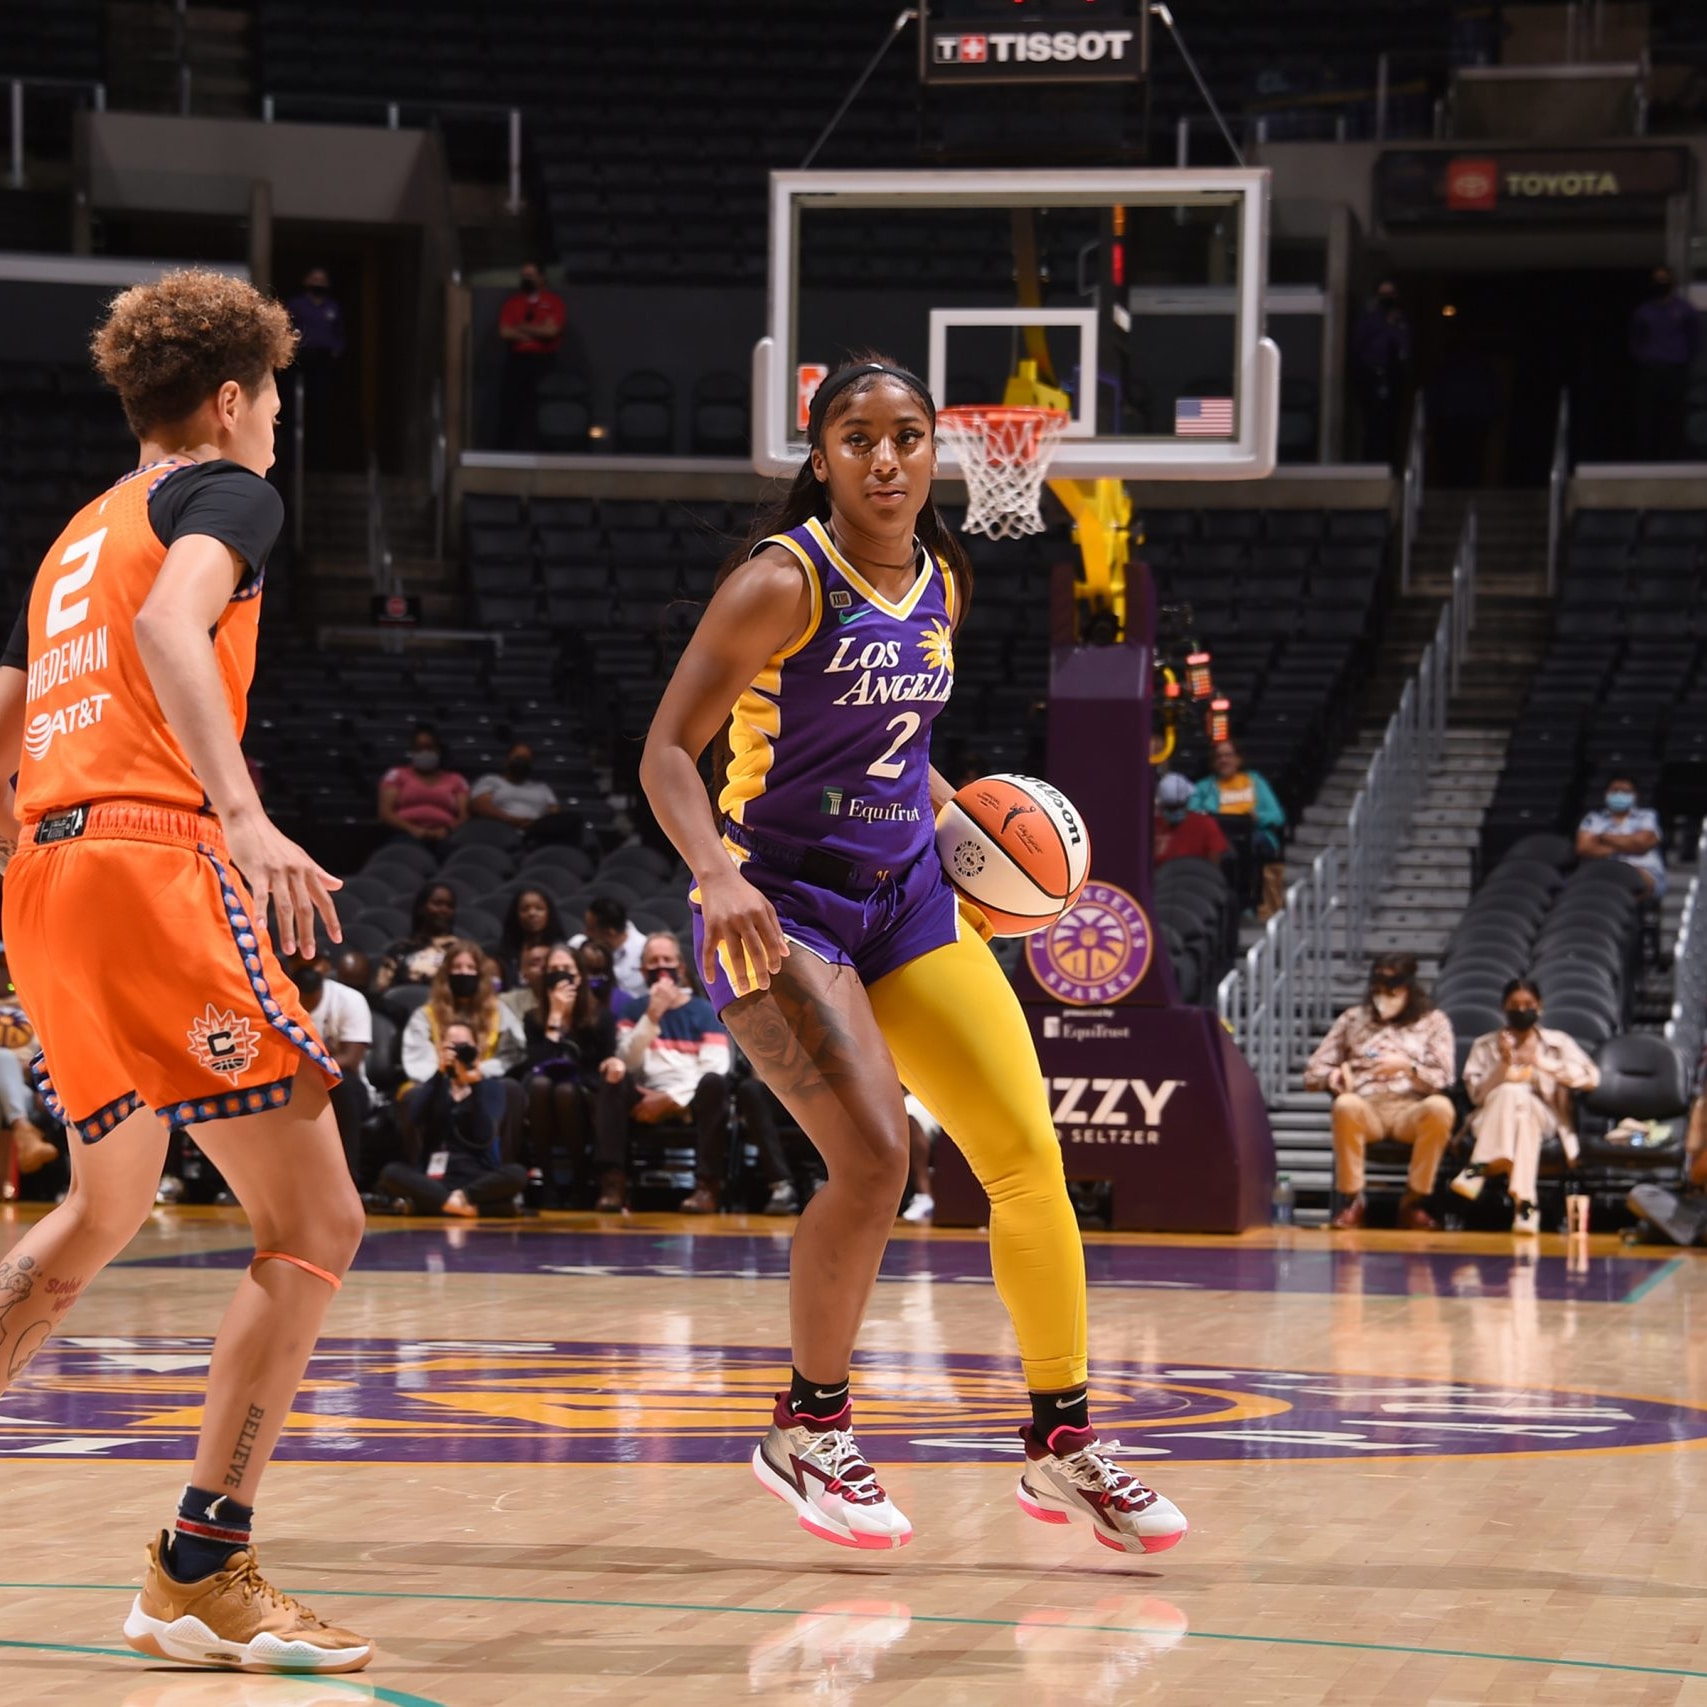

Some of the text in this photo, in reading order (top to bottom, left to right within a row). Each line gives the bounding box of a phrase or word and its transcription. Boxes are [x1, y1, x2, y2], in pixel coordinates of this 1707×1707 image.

[989, 30, 1133, 62] TISSOT
[1506, 172, 1619, 196] TOYOTA
[46, 527, 108, 638] 2
[26, 625, 107, 704] HIEDEMAN
[51, 693, 112, 735] AT&T
[866, 711, 921, 779] 2
[1080, 887, 1146, 949] NGELES
[1045, 971, 1133, 1001] SPARKS
[1071, 1129, 1160, 1145] SELTZER
[223, 1403, 264, 1488] BELIEVE
